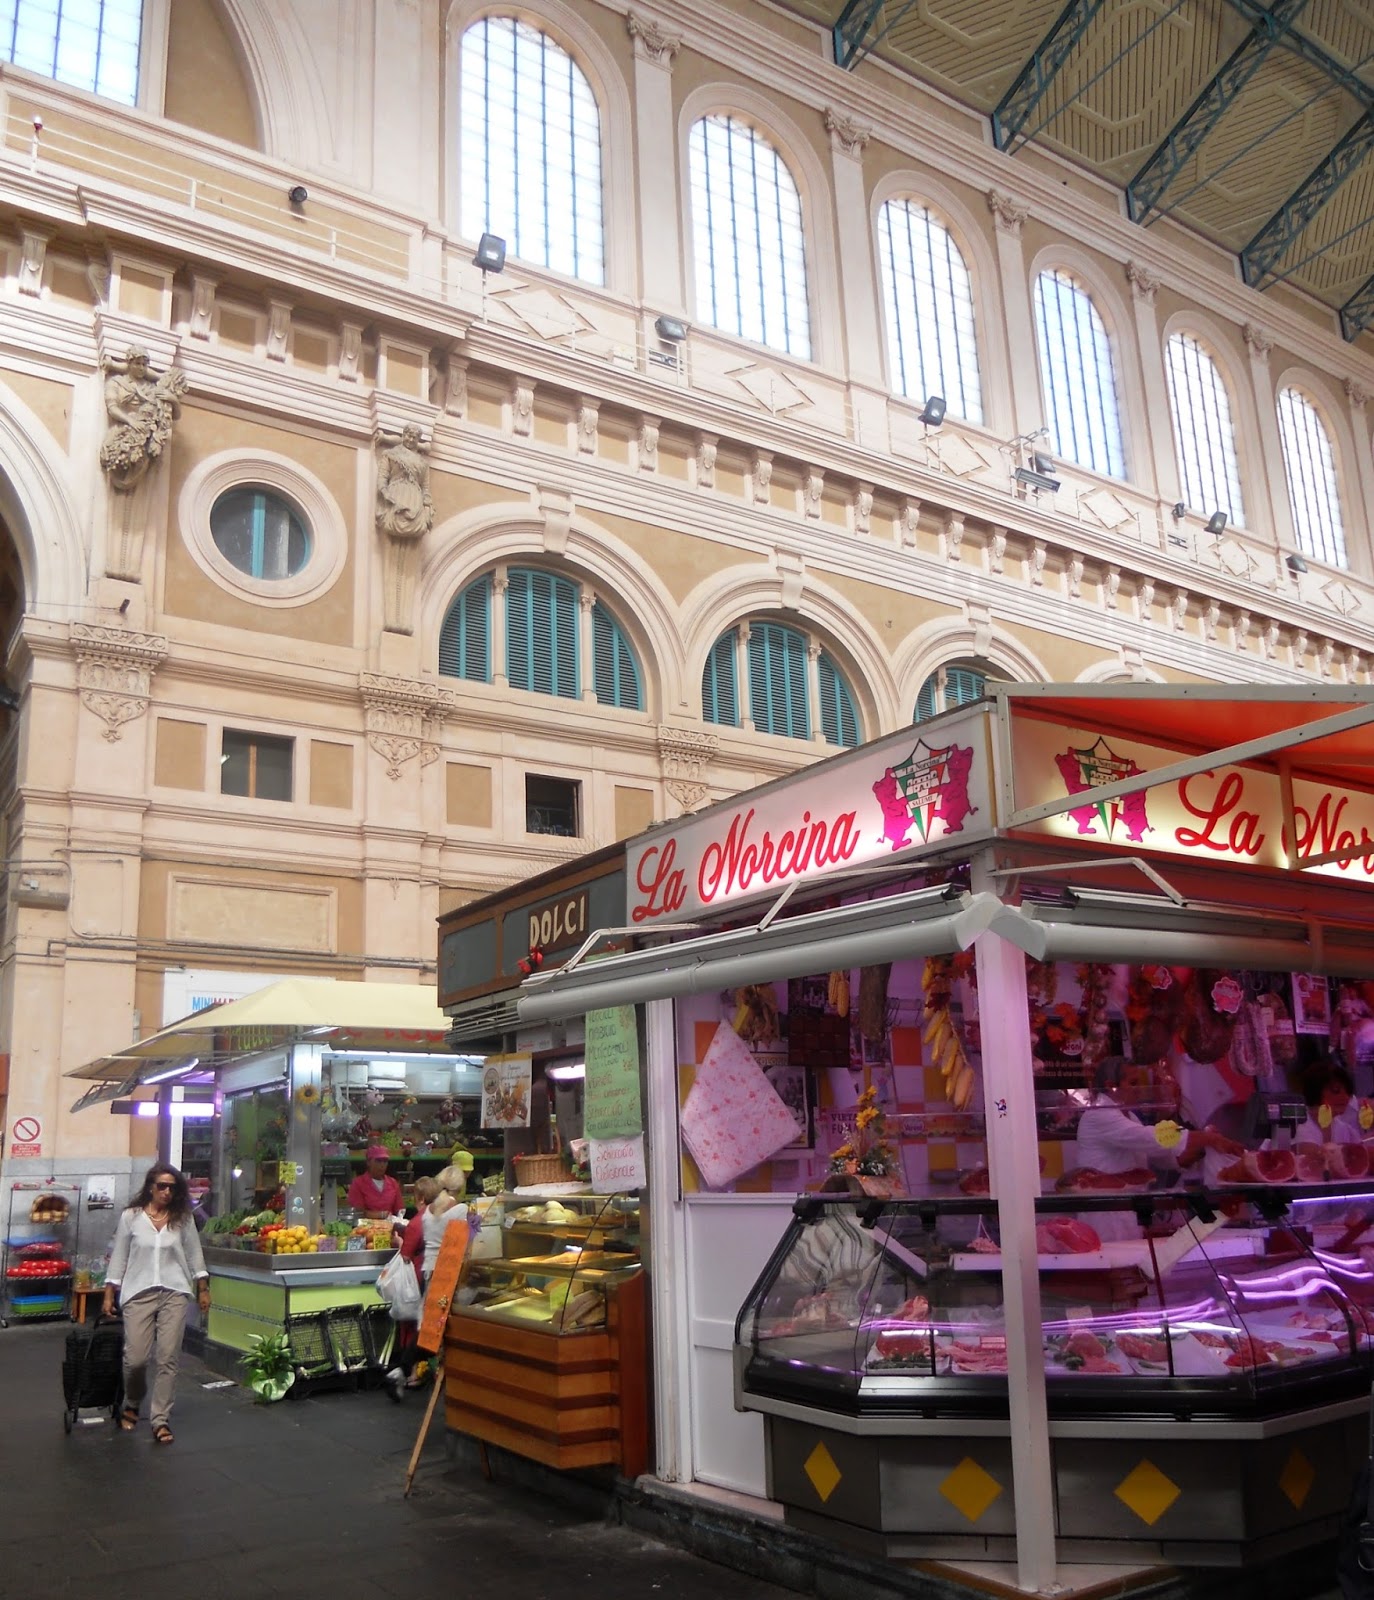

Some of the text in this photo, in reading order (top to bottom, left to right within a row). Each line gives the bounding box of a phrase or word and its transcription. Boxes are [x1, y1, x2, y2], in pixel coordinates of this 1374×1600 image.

[1175, 770, 1265, 856] La
[632, 808, 860, 923] La Norcina
[530, 896, 585, 947] DOLCI
